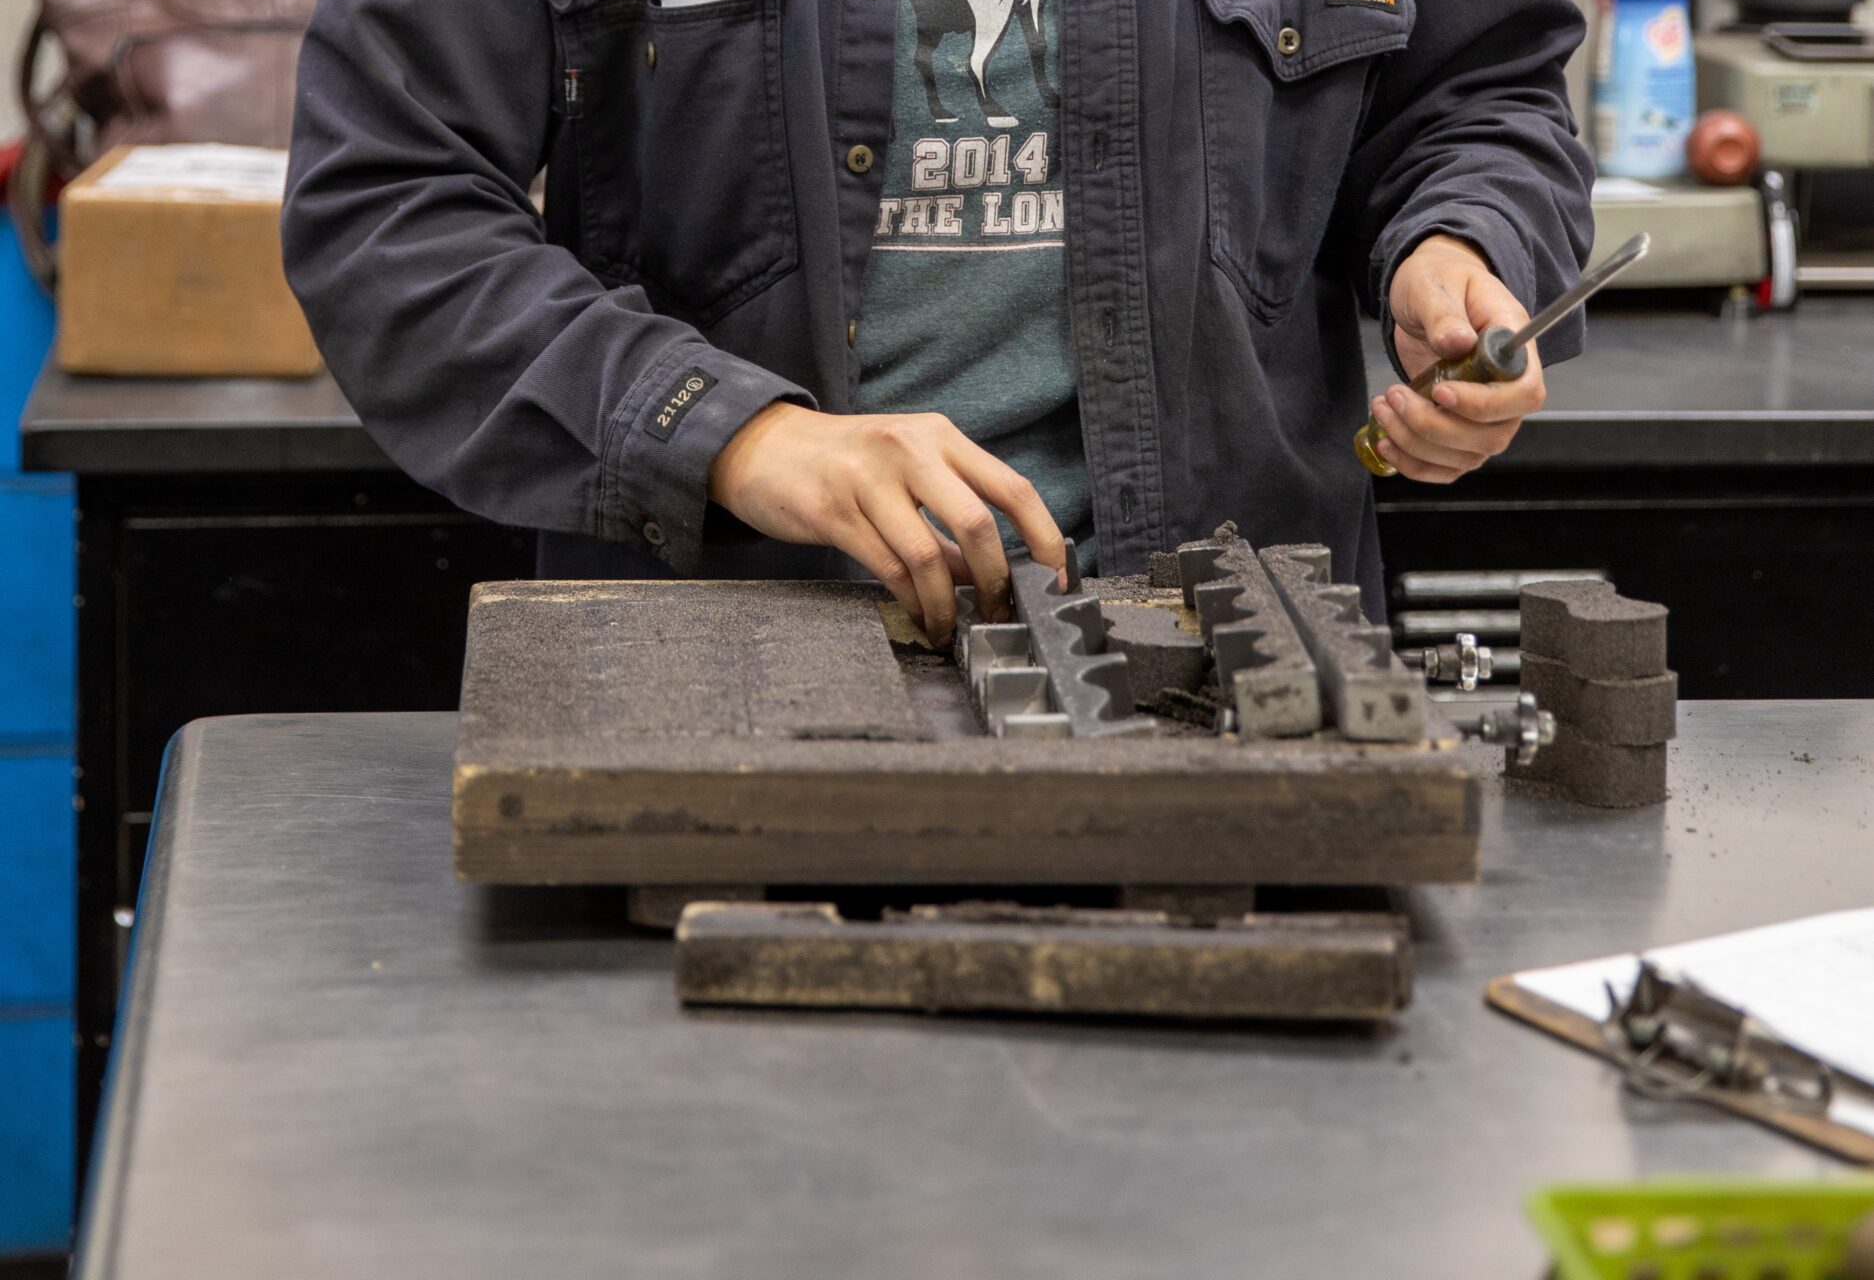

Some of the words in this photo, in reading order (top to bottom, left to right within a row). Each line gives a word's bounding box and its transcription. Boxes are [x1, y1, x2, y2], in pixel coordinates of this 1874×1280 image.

[912, 132, 1048, 190] 2014
[873, 194, 964, 236] THE
[981, 190, 1065, 235] LON
[657, 389, 692, 427] 2112
